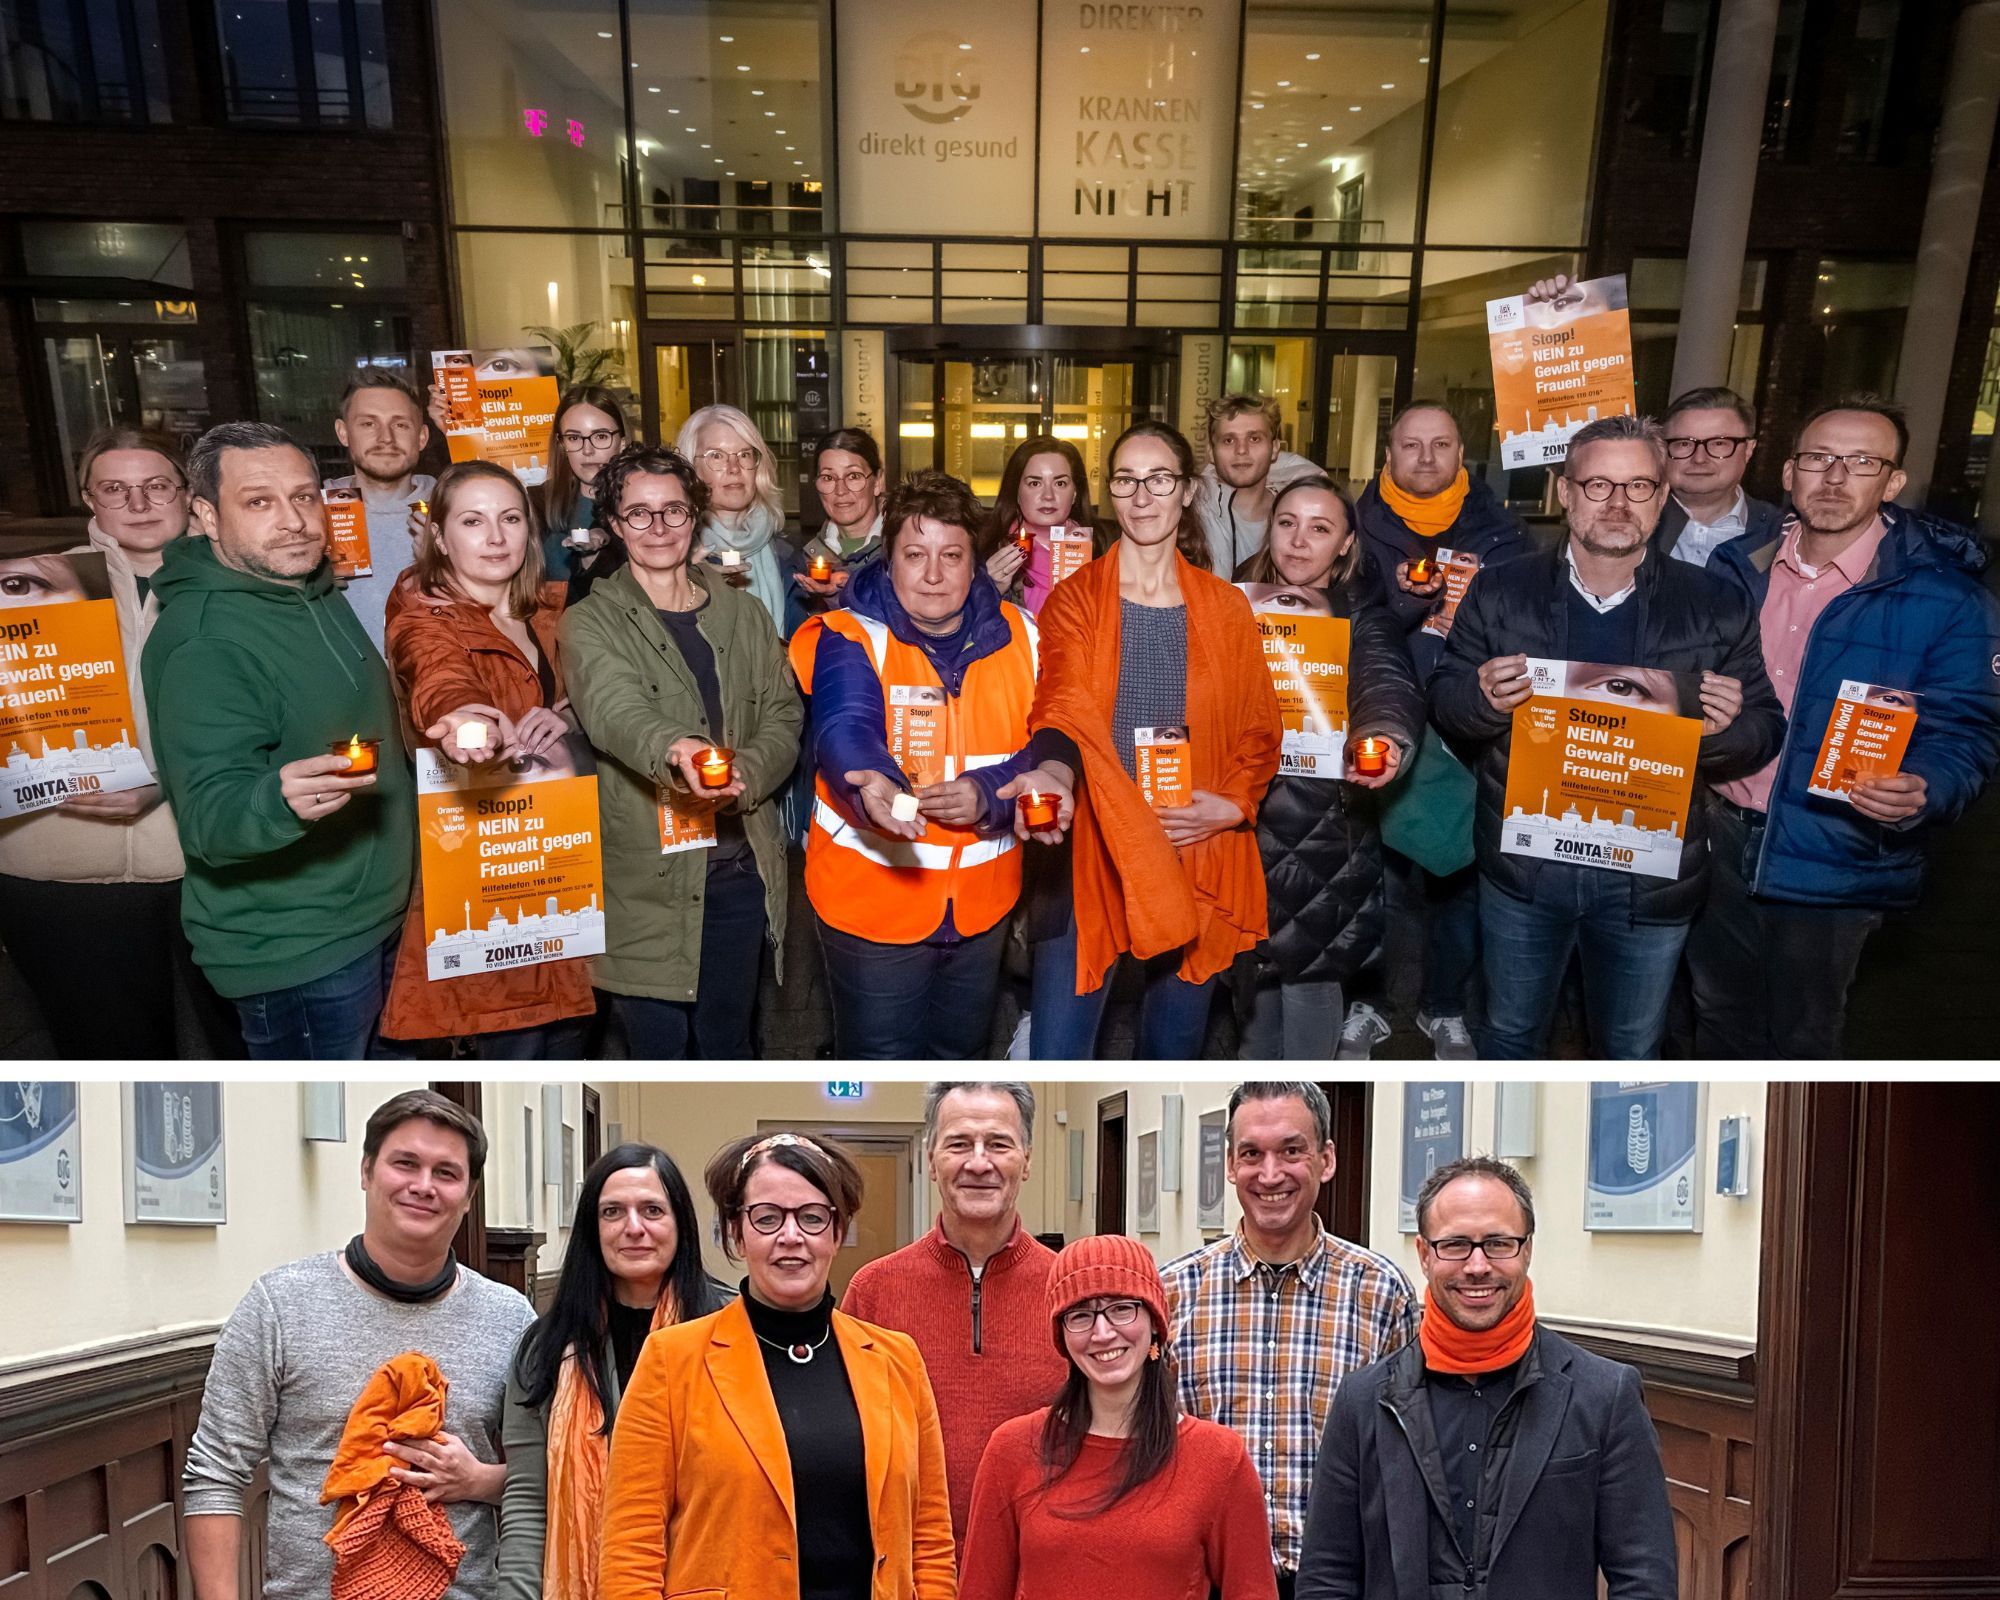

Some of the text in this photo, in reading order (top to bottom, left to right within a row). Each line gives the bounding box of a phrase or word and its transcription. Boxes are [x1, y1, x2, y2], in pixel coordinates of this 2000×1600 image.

[1079, 96, 1201, 122] KRANKEN
[858, 132, 1017, 163] direkt gesund
[1076, 131, 1197, 170] KASSE
[1075, 177, 1196, 216] NICHT
[1532, 328, 1575, 346] Stopp!
[808, 355, 816, 369] 1
[1533, 346, 1564, 363] NEIN
[1568, 345, 1584, 356] zu
[1535, 354, 1625, 378] Gewalt gegen
[1536, 375, 1586, 394] Frauen!
[509, 402, 522, 411] zu
[483, 428, 527, 441] Frauen!
[0, 618, 40, 640] opp!
[33, 643, 57, 658] zu
[1263, 639, 1305, 654] EIN zu
[0, 660, 115, 686] ewalt gegen
[1267, 658, 1343, 677] walt gegen
[0, 684, 66, 709] rauen!
[54, 709, 69, 717] 116
[910, 709, 932, 717] Stopp!
[1531, 706, 1556, 715] Orange
[1569, 708, 1626, 730] Stopp!
[1863, 708, 1895, 720] Stopp!
[893, 708, 904, 735] World
[1534, 721, 1554, 729] World
[1860, 719, 1883, 729] NEIN
[893, 736, 902, 752] the
[909, 740, 930, 748] gegen
[1567, 725, 1634, 749] NEIN zu
[1818, 703, 1854, 779] Orange the World
[1853, 739, 1882, 749] gegen
[1857, 729, 1890, 741] Gewalt
[1155, 747, 1177, 755] Stopp!
[1850, 746, 1887, 760] Frauen!
[1140, 748, 1150, 773] World
[1300, 756, 1316, 769] NO
[1565, 743, 1684, 778] Gewalt gegen
[1563, 761, 1629, 784] Frauen!
[13, 778, 68, 804] ZONTA
[78, 775, 100, 791] NO
[1561, 780, 1609, 795] Hilfetelefon
[1612, 789, 1626, 797] 116
[437, 806, 464, 815] Orange
[477, 794, 533, 815] Stopp!
[443, 823, 465, 832] World
[478, 817, 544, 836] NEIN zu
[663, 805, 673, 836] Orange
[480, 831, 592, 857] Gewalt gegen
[1554, 838, 1602, 858] ZONTA
[1612, 847, 1634, 863] NO
[480, 855, 545, 878] Frauen!
[1562, 853, 1586, 862] VIOLENCE
[1587, 858, 1610, 866] AGAINST
[1611, 861, 1632, 869] WOMEN
[482, 881, 530, 893] Hilfetelefon
[533, 878, 546, 886] 116
[485, 943, 534, 963] ZONTA
[543, 938, 564, 953] NO
[494, 959, 519, 968] VIOLENCE
[520, 955, 542, 963] AGAINST
